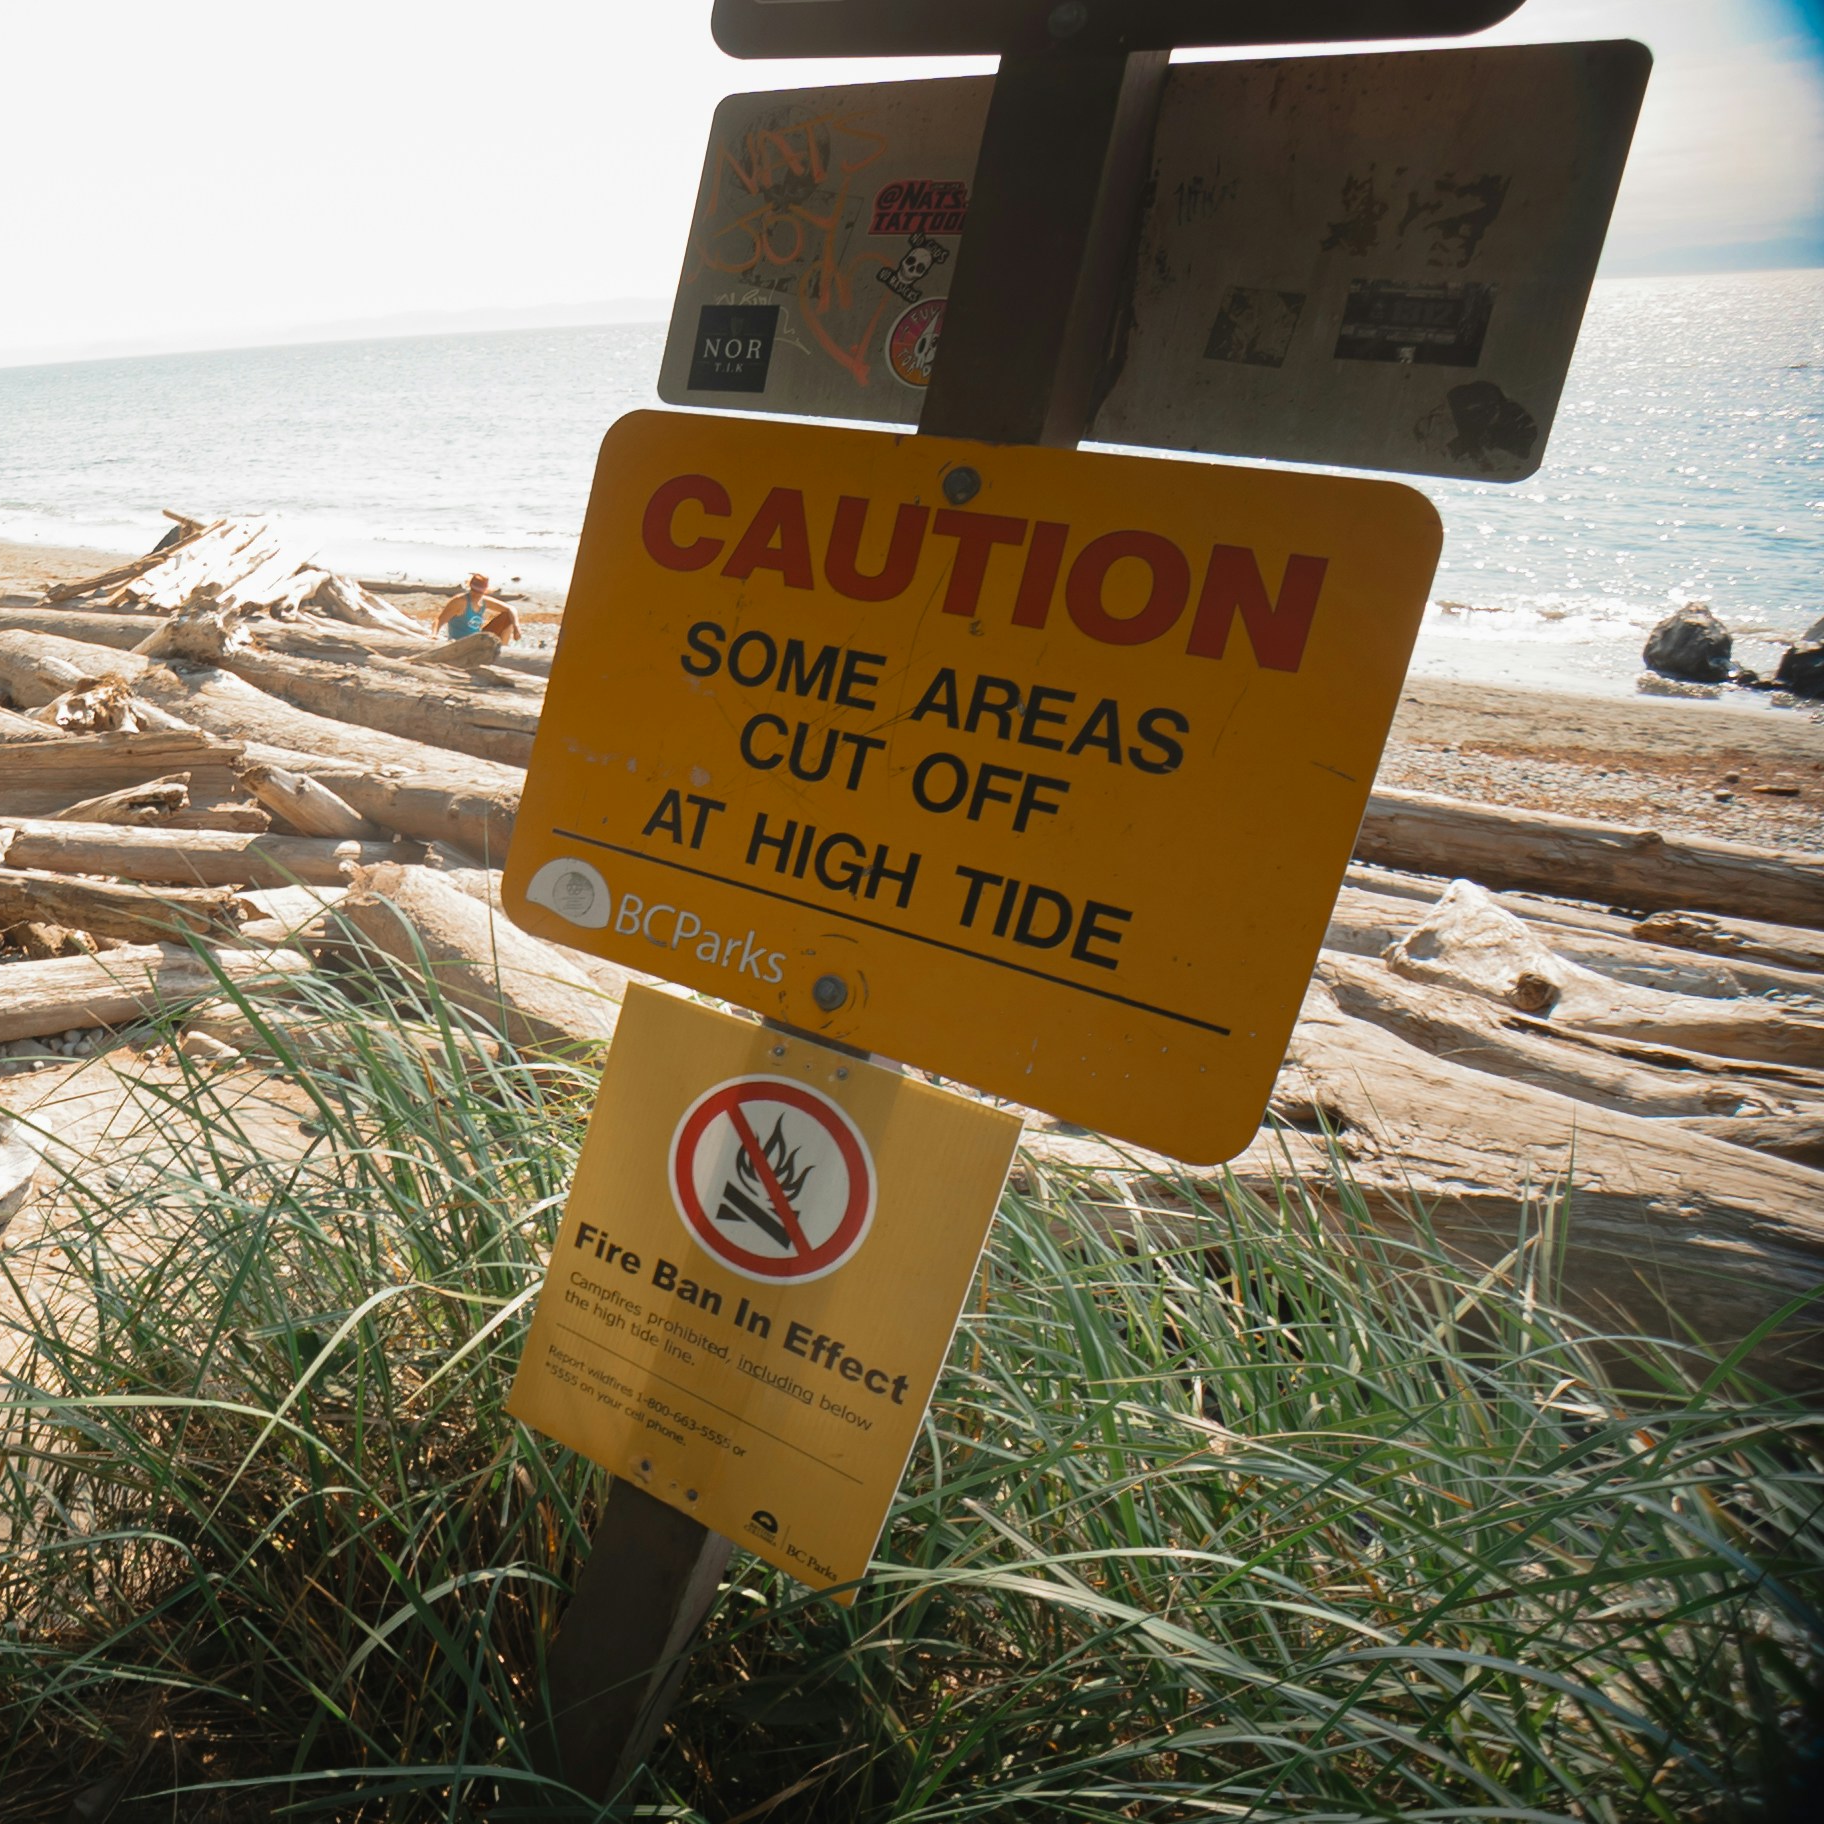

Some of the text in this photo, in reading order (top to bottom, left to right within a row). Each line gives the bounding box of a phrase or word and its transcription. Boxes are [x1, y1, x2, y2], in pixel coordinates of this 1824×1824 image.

[703, 338, 762, 359] NOR
[641, 473, 1329, 673] CAUTION
[680, 621, 1190, 775] SOME AREAS
[739, 713, 1070, 833] CUT OFF
[641, 788, 1133, 971] AT HIGH TIDE
[565, 1290, 696, 1366] the high tide line.
[569, 1271, 874, 1430] Campfires prohibited, including below
[573, 1222, 910, 1406] Fire Ban In Effect
[549, 1344, 747, 1457] Report wildfires 1-800-663-5555 or
[580, 1382, 594, 1396] on
[597, 1391, 623, 1410] your
[625, 1406, 645, 1423] cell
[646, 1418, 687, 1447] phone.
[785, 1544, 838, 1582] BC Parks
